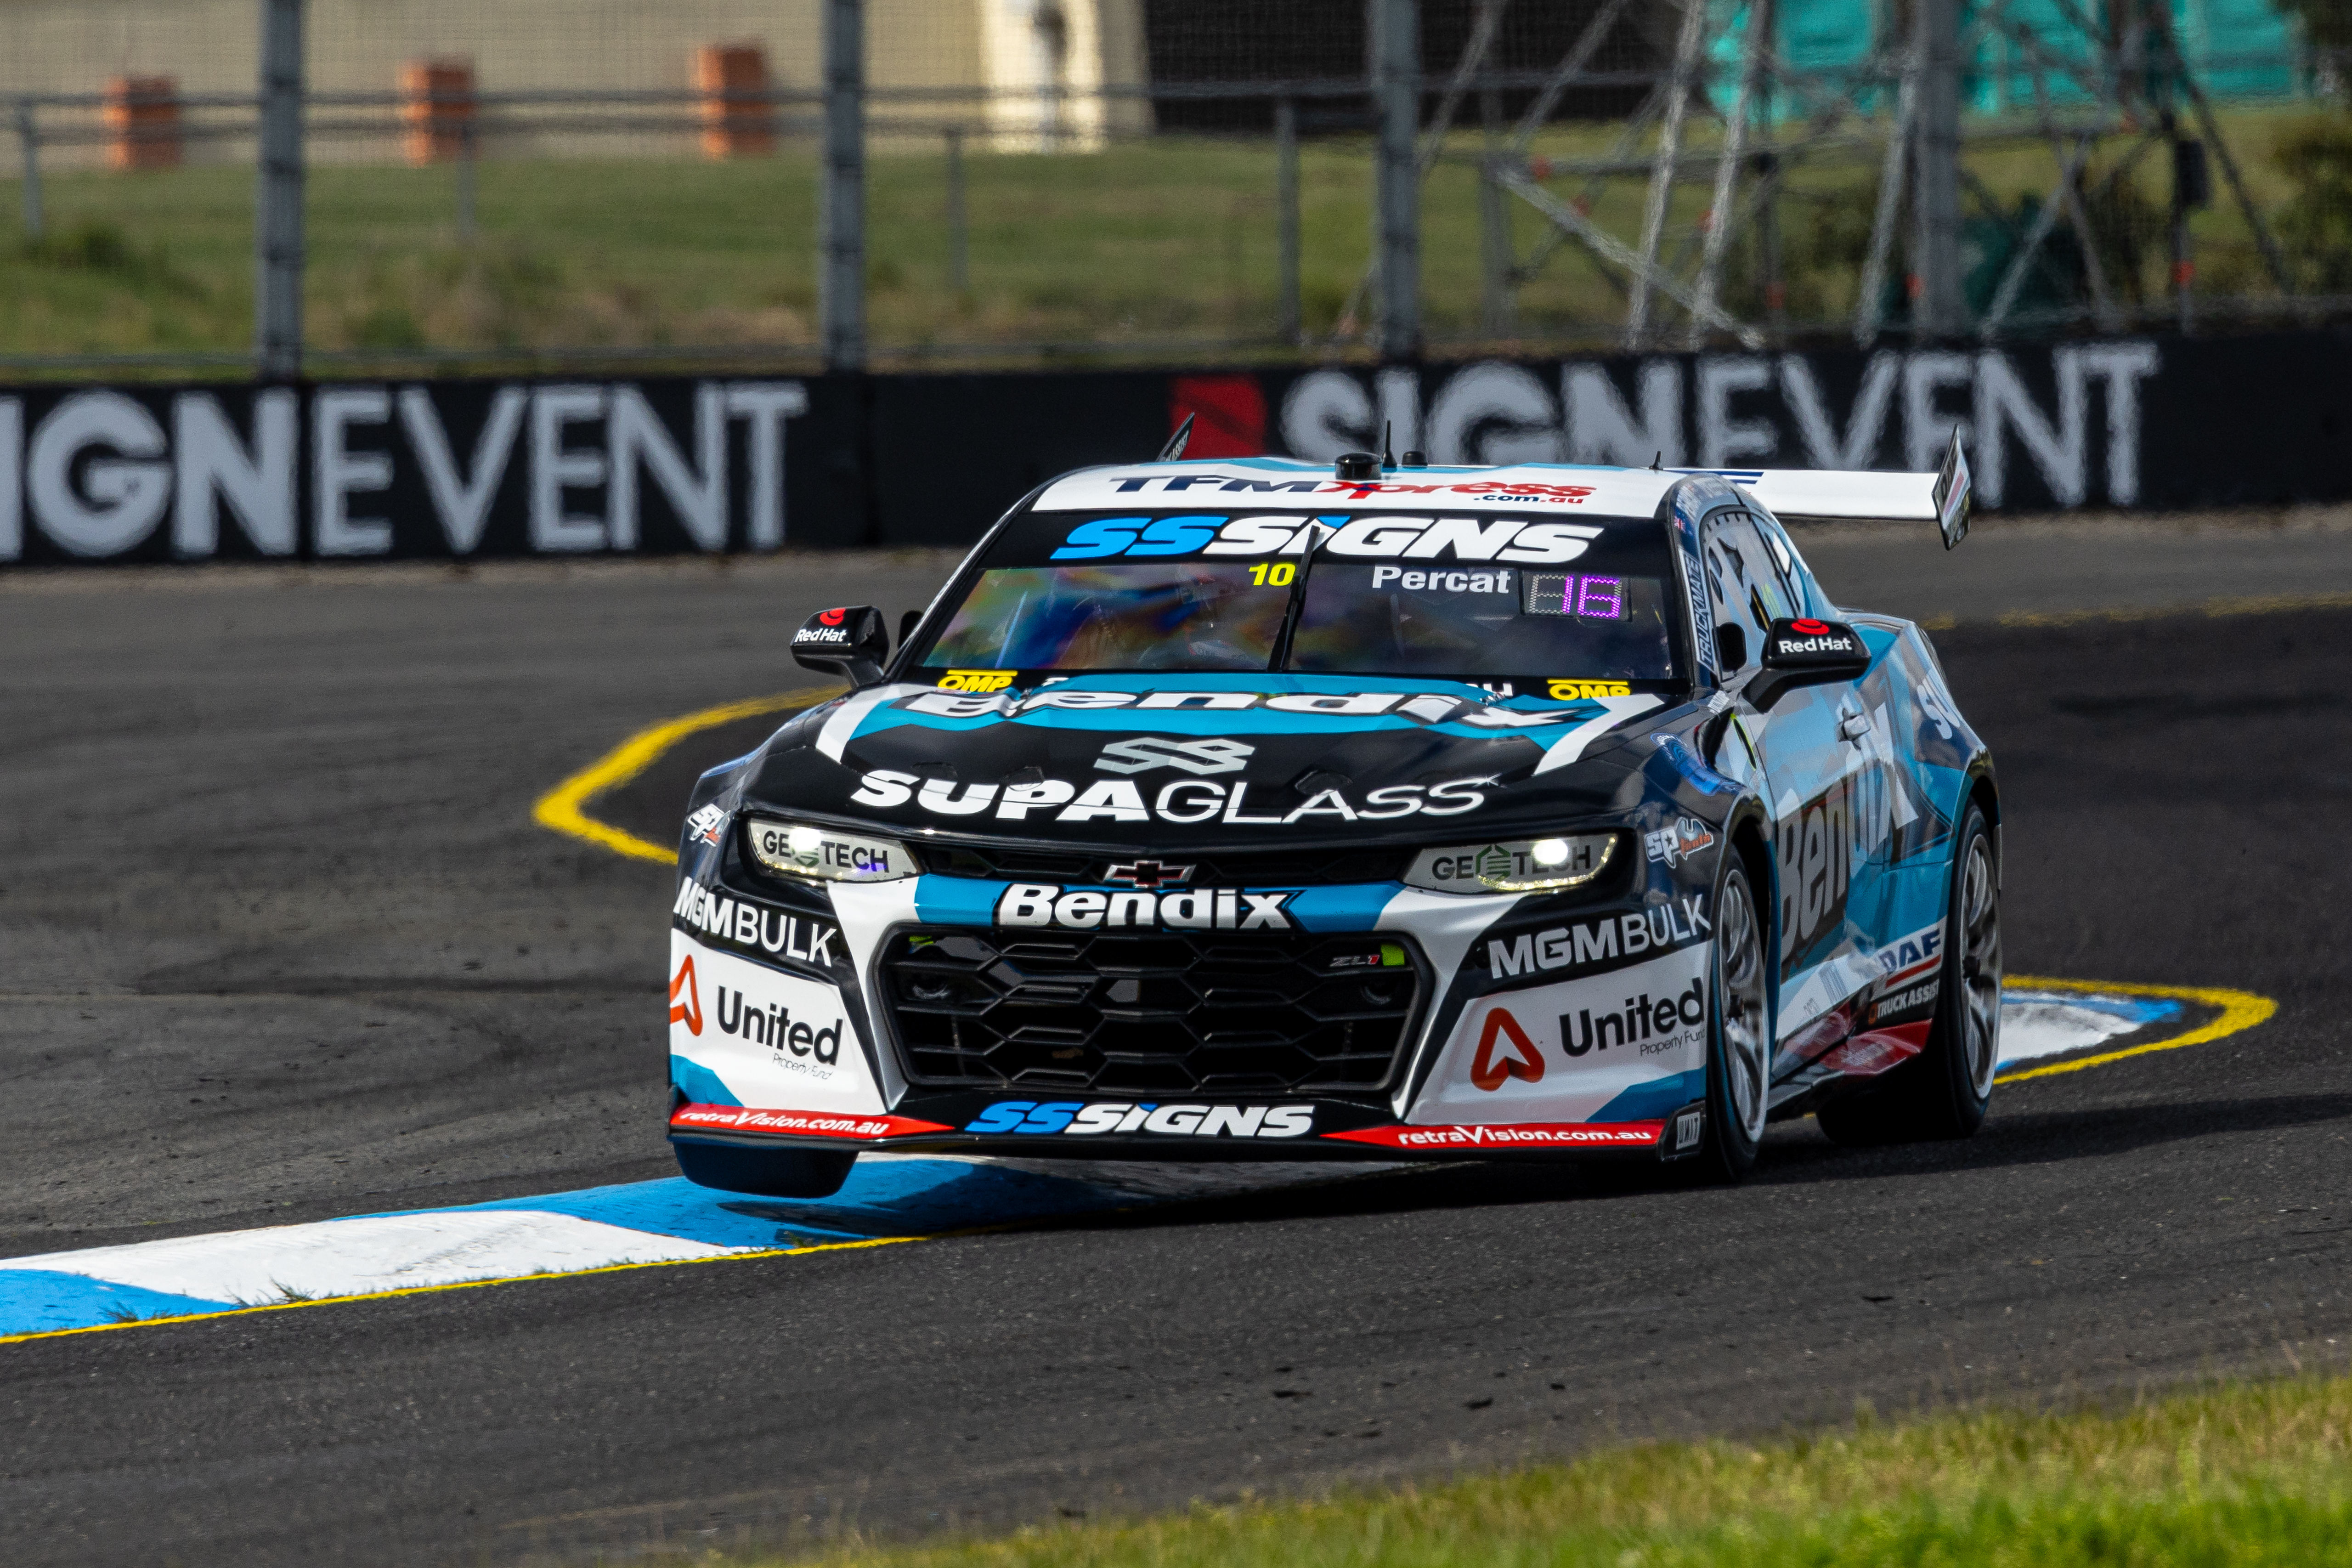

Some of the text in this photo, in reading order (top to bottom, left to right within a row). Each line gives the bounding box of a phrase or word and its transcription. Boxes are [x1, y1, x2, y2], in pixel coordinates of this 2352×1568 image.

[1249, 563, 1296, 587] 10
[1372, 566, 1511, 594] Percat
[1561, 574, 1622, 618] 16
[938, 675, 1013, 692] OMP
[763, 829, 890, 873] GETECH
[999, 883, 1292, 929] Bendix
[1879, 928, 1940, 975] DAF
[718, 985, 843, 1066] United
[1559, 977, 1705, 1057] United
[1640, 1035, 1683, 1057] Property
[1397, 1126, 1652, 1144] retraVision.com.au
